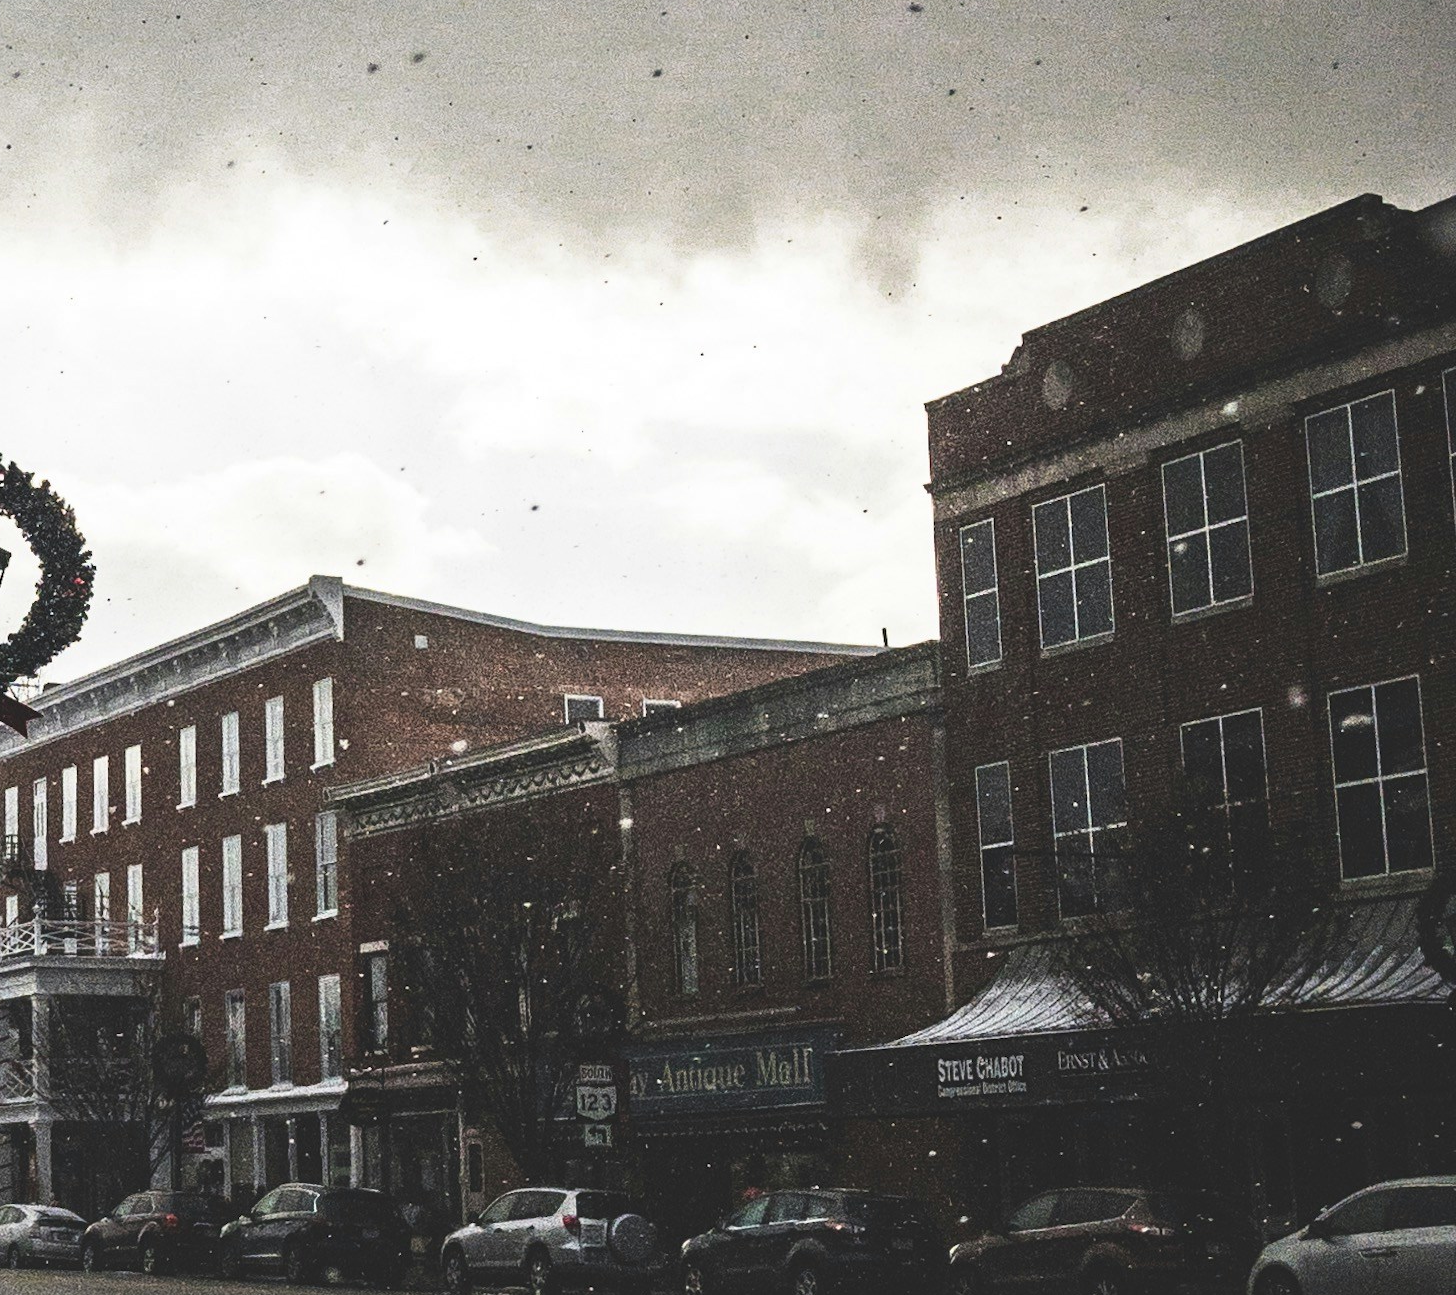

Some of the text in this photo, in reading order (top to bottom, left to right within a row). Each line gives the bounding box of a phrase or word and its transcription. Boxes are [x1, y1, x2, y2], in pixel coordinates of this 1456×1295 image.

[660, 1060, 746, 1092] Antique
[756, 1048, 812, 1086] Mall
[938, 1055, 1024, 1082] STEVE CHABOT
[580, 1093, 613, 1111] 123
